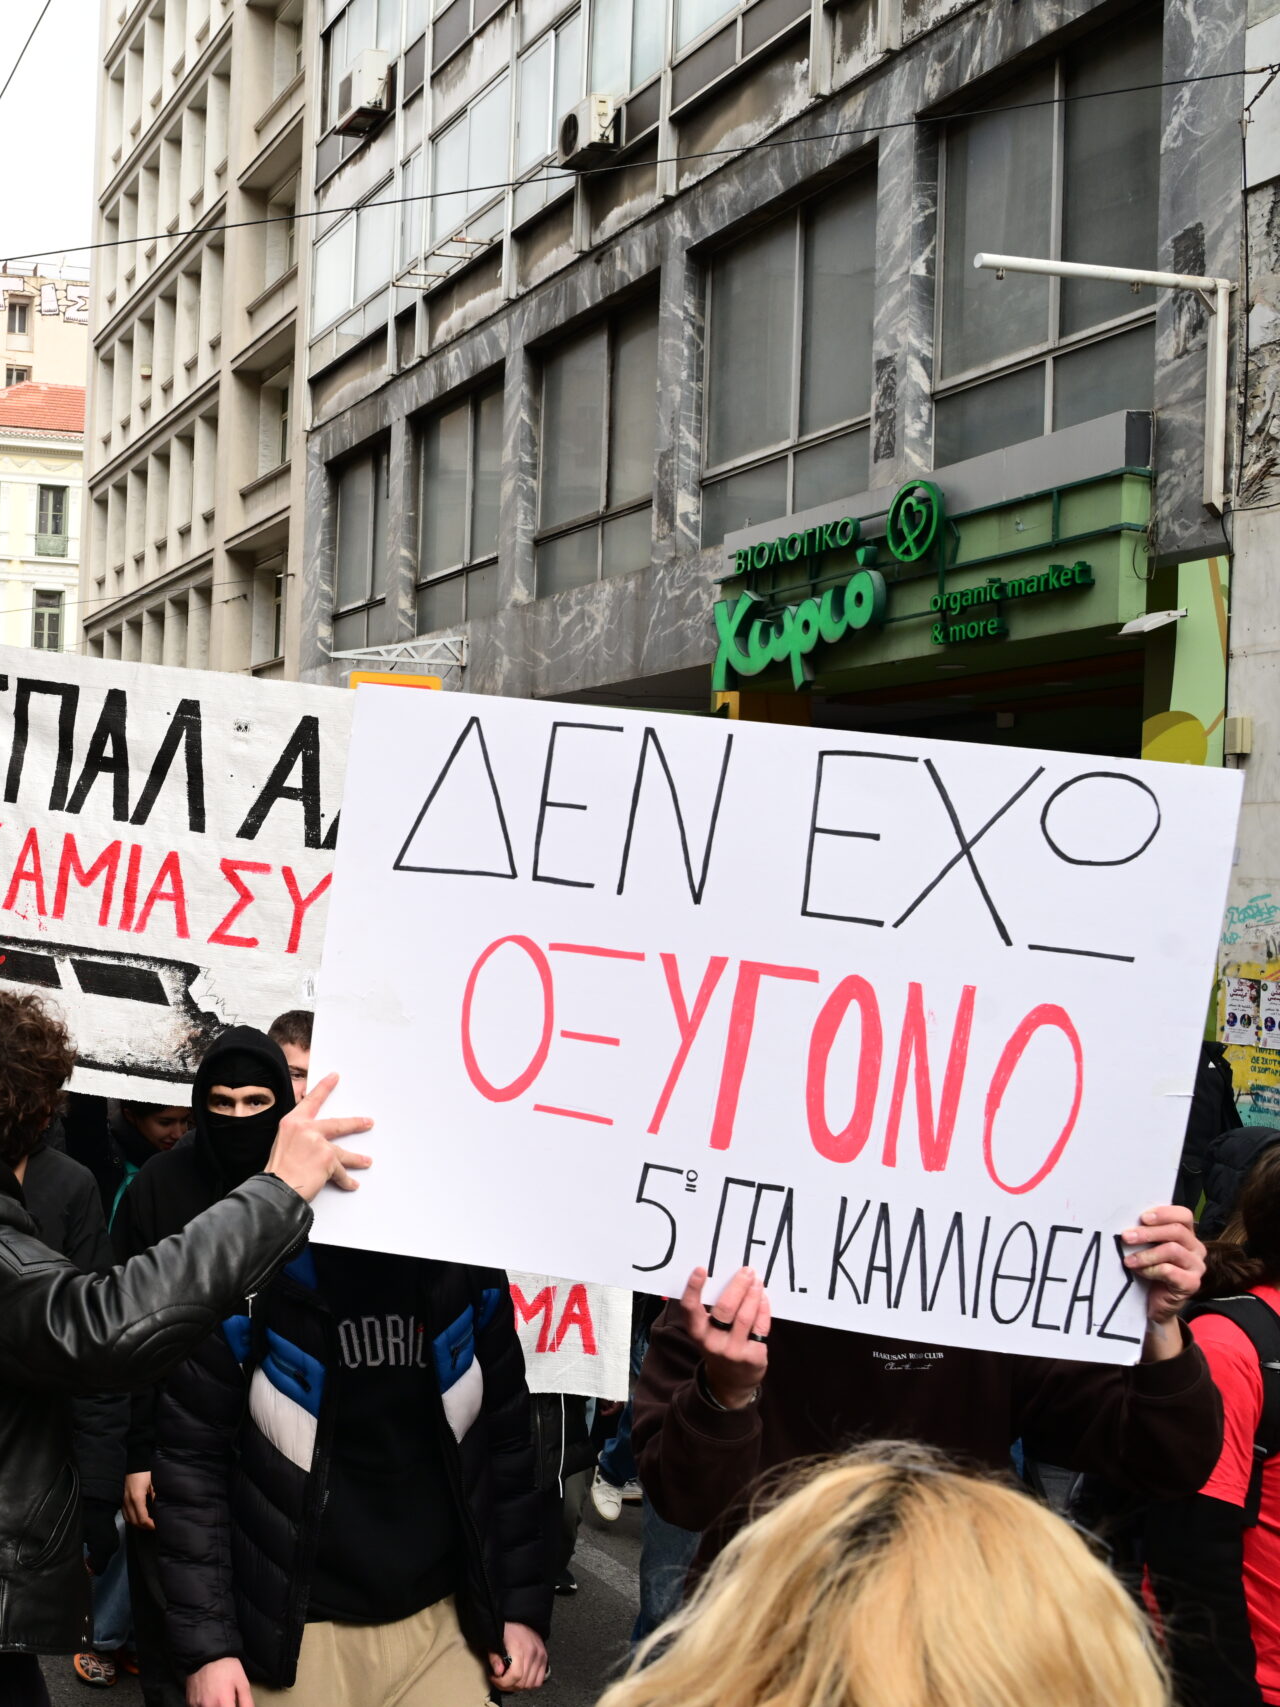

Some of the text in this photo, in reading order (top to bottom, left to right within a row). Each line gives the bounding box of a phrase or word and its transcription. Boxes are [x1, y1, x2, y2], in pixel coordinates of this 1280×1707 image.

[734, 516, 857, 575] ΒΙΟΛΟΓΙΚΟ
[929, 562, 1087, 616] organic market
[711, 545, 884, 692] Χωριό
[930, 616, 999, 645] & more
[236, 714, 341, 851] Α
[392, 715, 735, 907] ΔΕΝ
[460, 933, 1085, 1196] ΟΞΥΓΟΝΟ
[872, 1351, 908, 1361] HAKUSAN
[924, 1352, 945, 1360] CLUB
